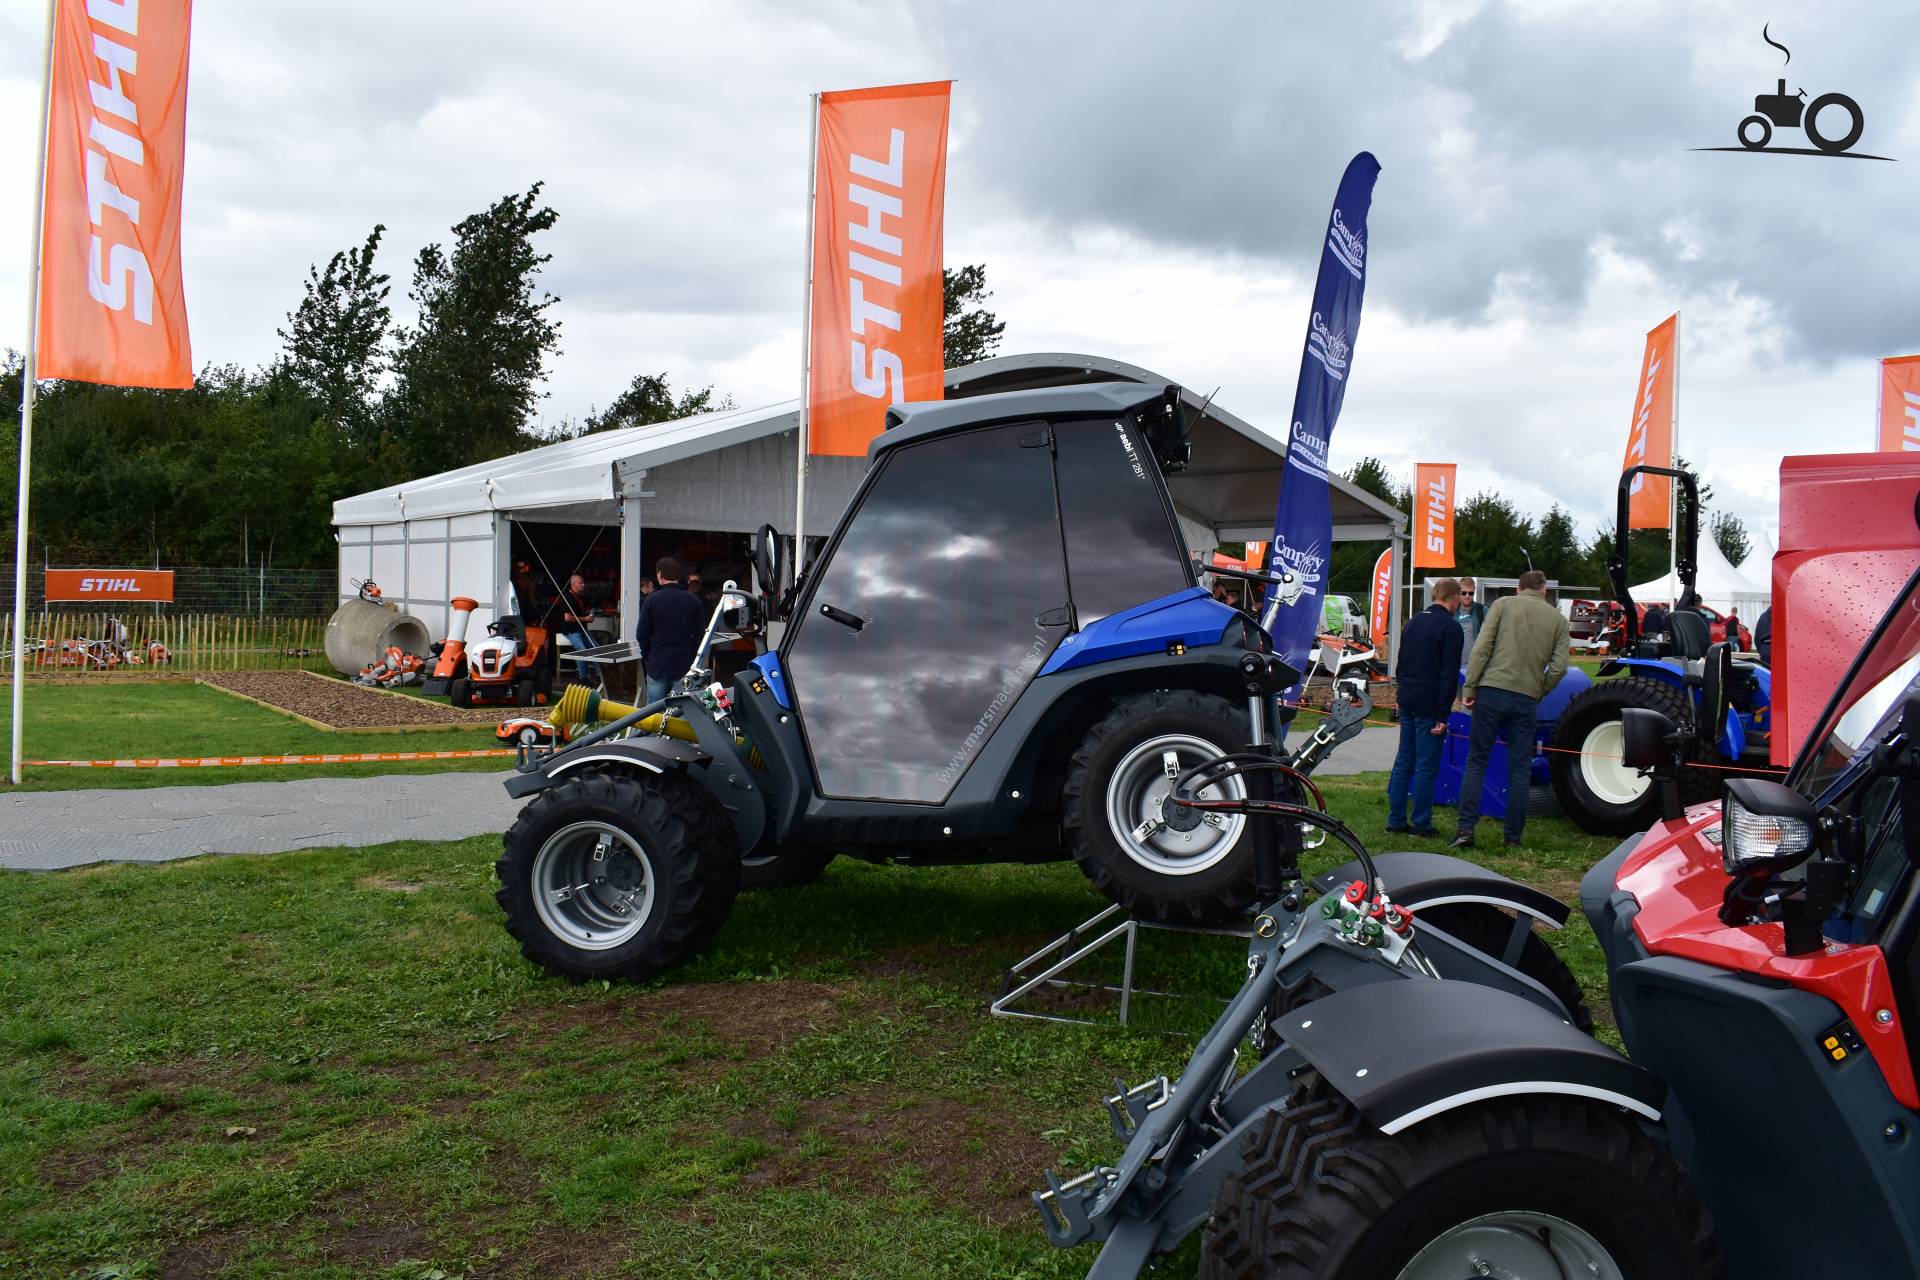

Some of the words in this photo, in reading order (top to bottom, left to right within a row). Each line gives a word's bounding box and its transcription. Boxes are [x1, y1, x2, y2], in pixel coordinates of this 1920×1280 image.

[848, 127, 906, 407] STIHL
[1120, 434, 1135, 452] aebi
[1128, 452, 1139, 461] TT
[1426, 475, 1446, 555] STIHL
[79, 578, 142, 592] STIHL
[1375, 565, 1392, 632] STIHL
